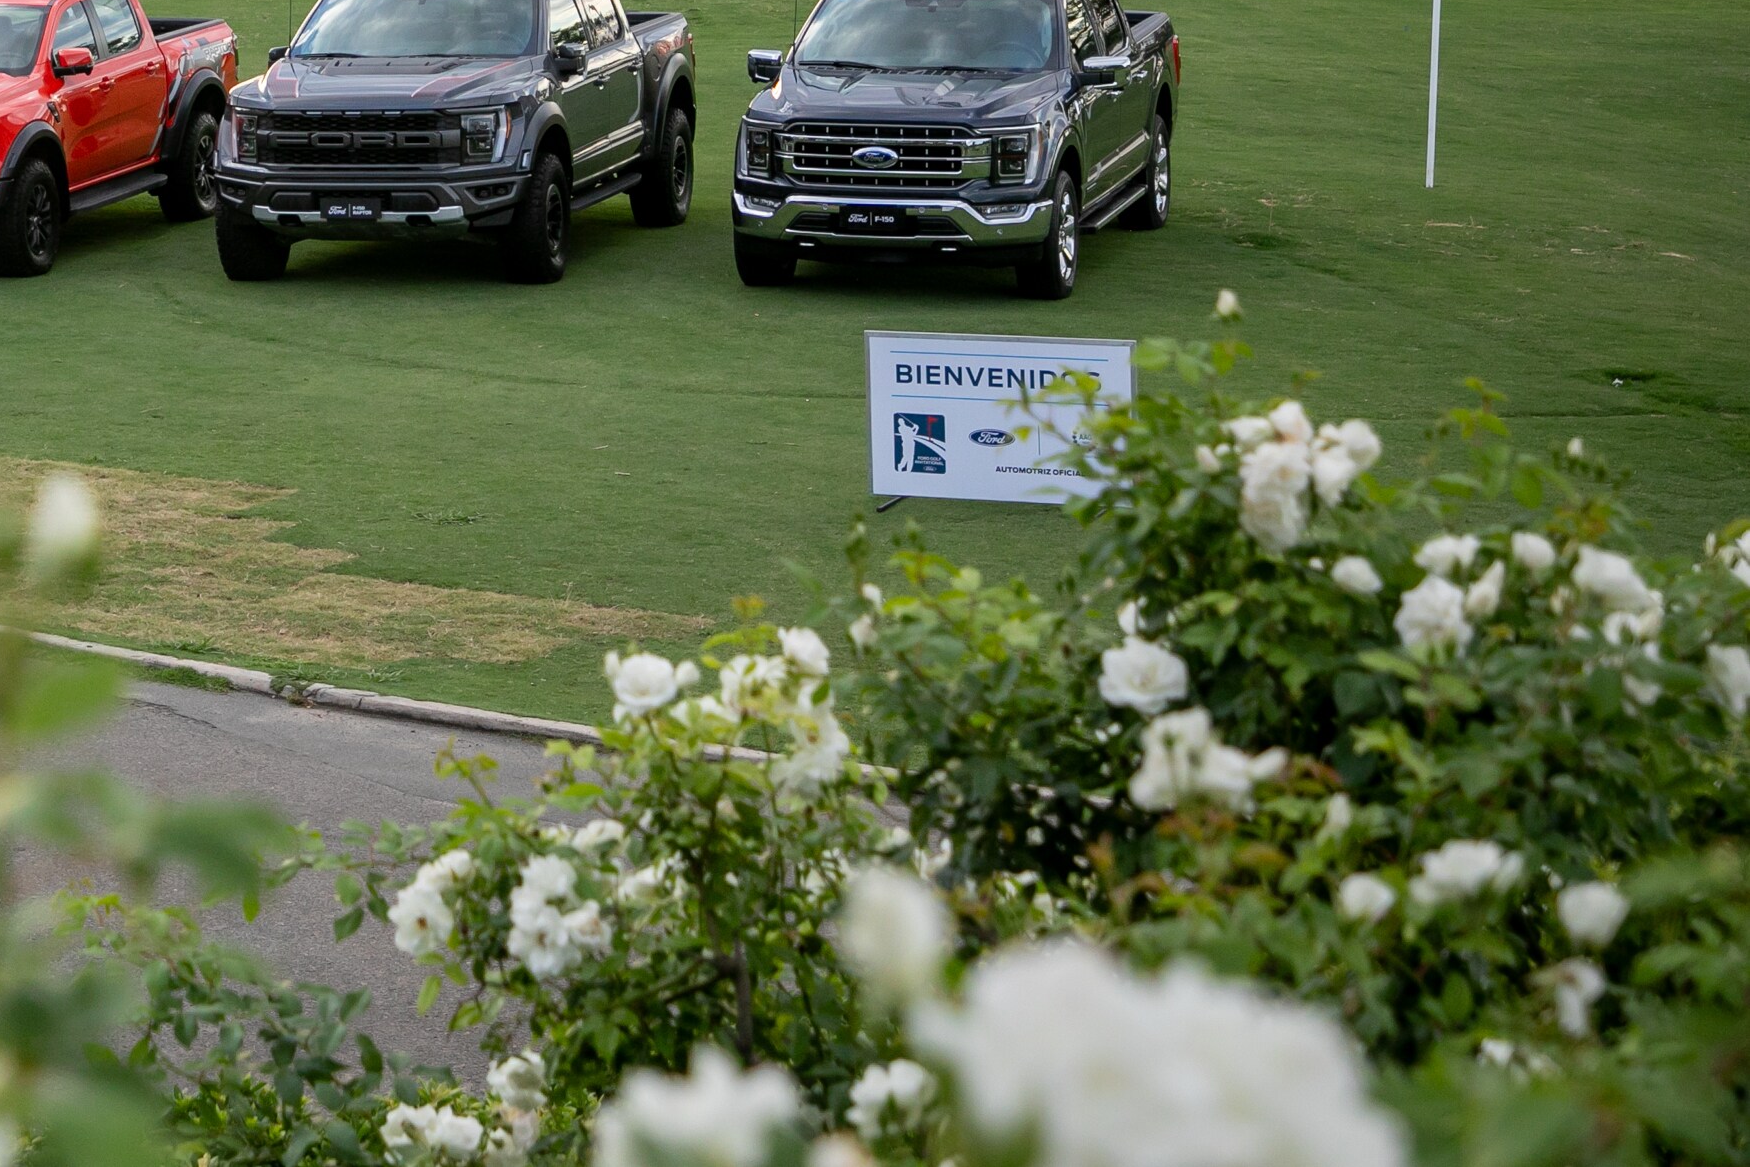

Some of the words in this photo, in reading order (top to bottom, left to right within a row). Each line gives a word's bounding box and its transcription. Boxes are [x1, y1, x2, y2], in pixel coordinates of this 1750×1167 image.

[268, 131, 441, 149] FORD
[864, 153, 886, 162] Ford
[328, 206, 347, 215] Ford
[848, 214, 868, 223] Ford
[976, 430, 1007, 445] Ford
[995, 465, 1052, 475] AUTOMOTRIZ
